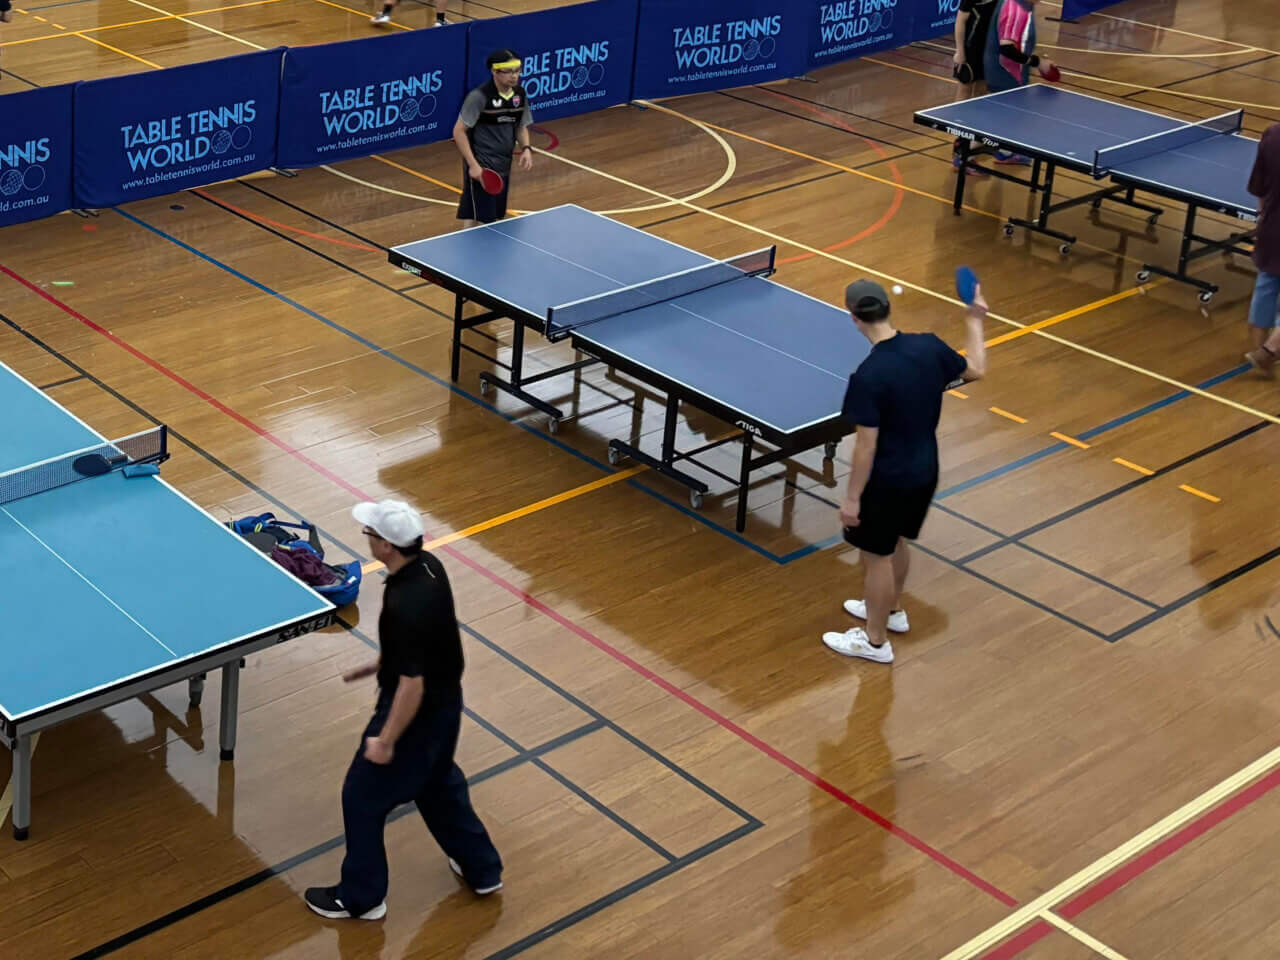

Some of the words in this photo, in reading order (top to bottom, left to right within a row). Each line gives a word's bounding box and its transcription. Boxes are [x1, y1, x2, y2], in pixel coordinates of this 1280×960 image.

[820, 0, 856, 25] TABLE
[673, 24, 721, 48] TABLE
[726, 15, 781, 41] TENNIS
[820, 16, 869, 45] WORLD
[520, 52, 550, 77] BLE
[554, 41, 609, 69] TENNIS
[675, 43, 742, 70] WORLD
[320, 85, 375, 113] TABLE
[380, 70, 443, 103] TENNIS
[521, 71, 571, 98] ORLD
[120, 116, 182, 149] TABLE
[187, 100, 256, 134] TENNIS
[323, 105, 400, 136] WORLD
[316, 121, 438, 153] www.tabletennisworld.com.au
[127, 136, 211, 173] WORLD
[122, 153, 256, 191] www.tabletennisworld.com.au
[735, 420, 762, 437] STIGA
